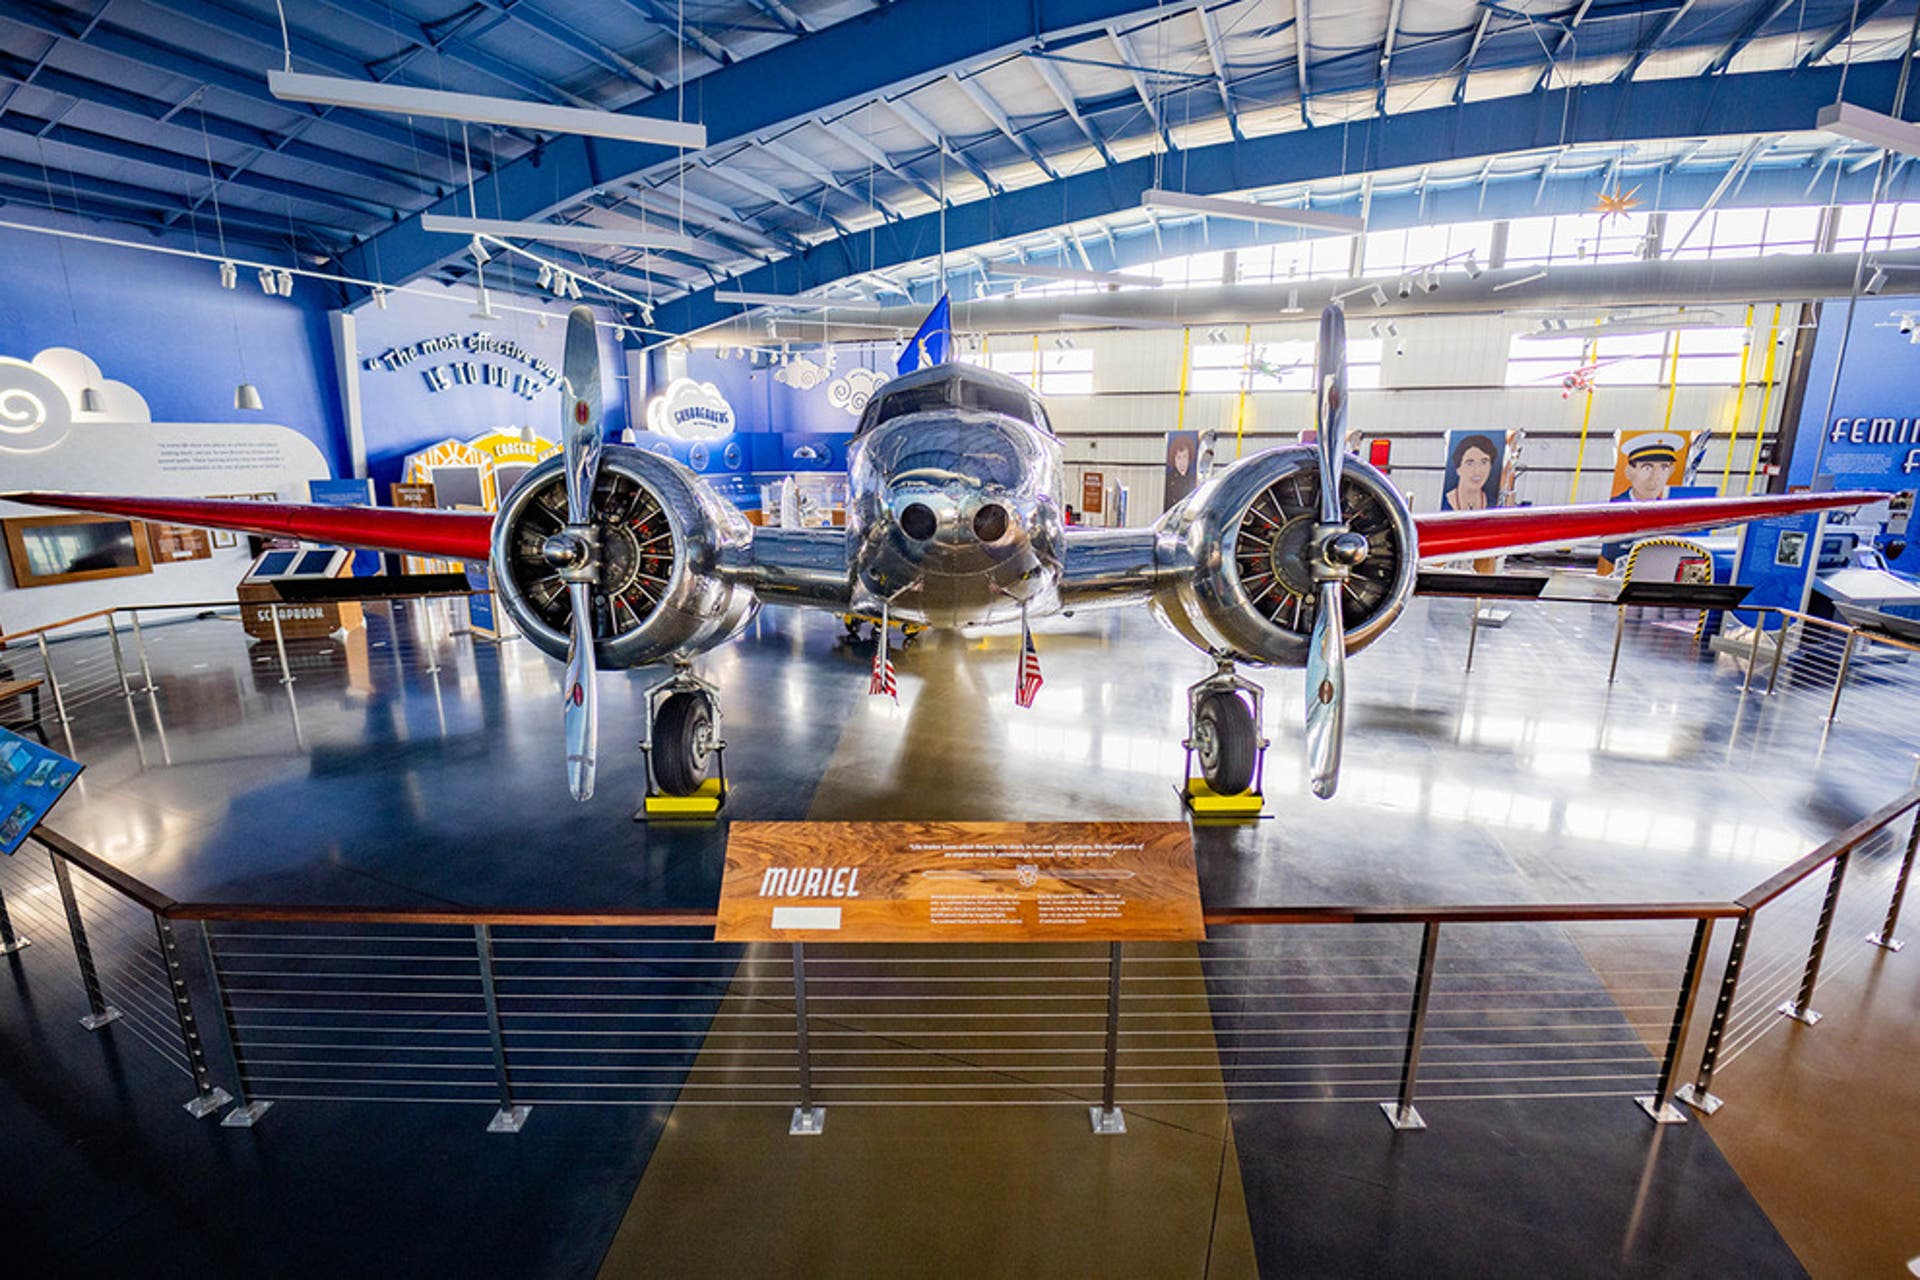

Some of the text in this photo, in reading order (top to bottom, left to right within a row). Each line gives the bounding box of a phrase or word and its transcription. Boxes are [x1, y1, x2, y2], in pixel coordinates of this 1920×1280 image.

[421, 333, 463, 356] most
[468, 331, 533, 364] effective
[425, 366, 451, 392] IS
[453, 362, 478, 385] TO
[486, 363, 511, 388] DO
[257, 606, 325, 622] SCAPBOOK
[759, 867, 860, 897] MURIEL
